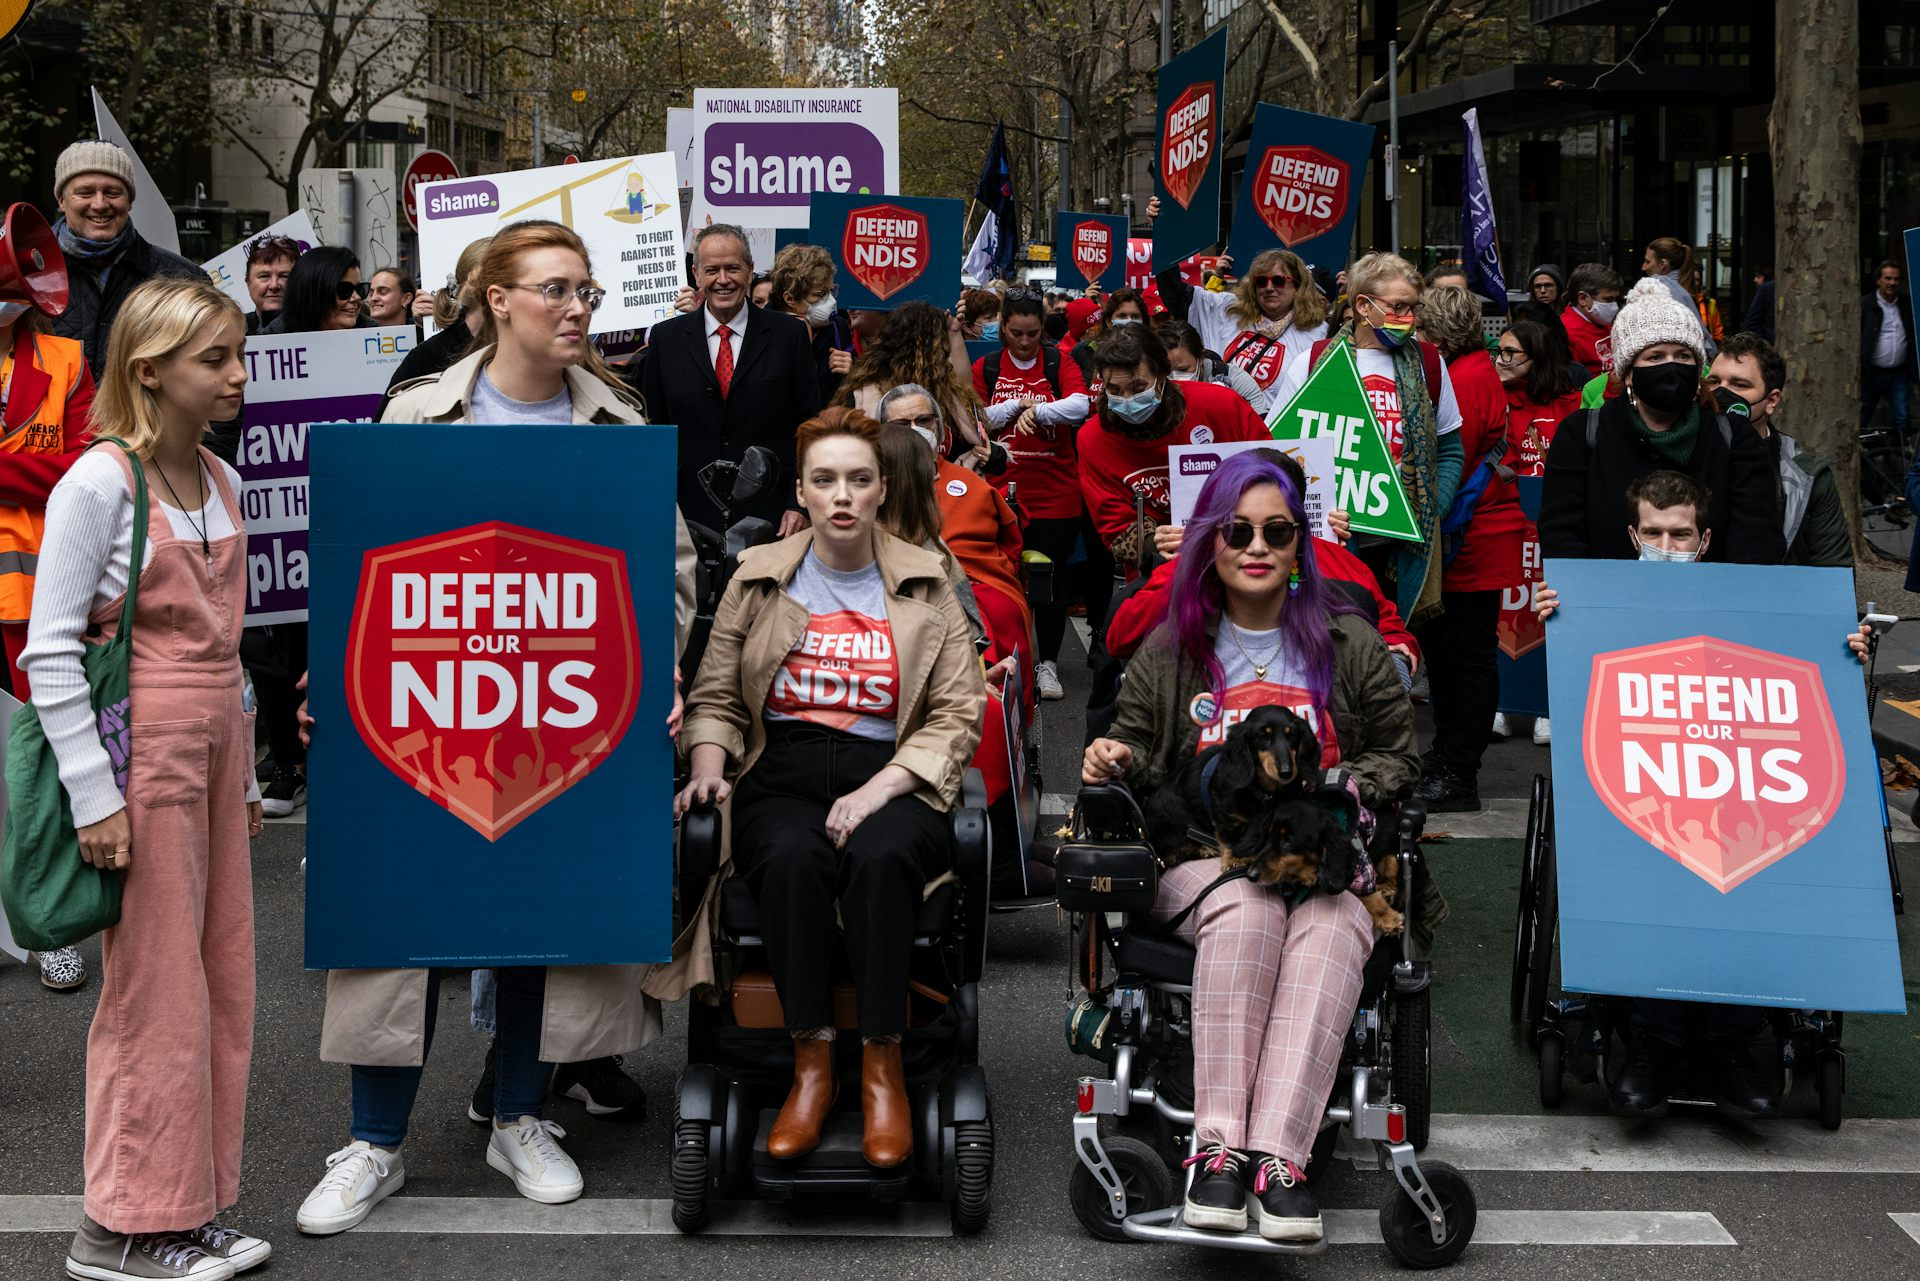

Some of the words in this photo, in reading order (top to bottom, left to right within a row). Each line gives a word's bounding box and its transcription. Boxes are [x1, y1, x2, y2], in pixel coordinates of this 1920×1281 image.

[706, 99, 751, 114] NATIONAL
[754, 99, 805, 114] DISABILITY
[808, 99, 862, 114] INSURANCE
[1170, 93, 1210, 138] DEFEND
[1183, 126, 1195, 139] OUR
[1168, 129, 1208, 176] NDIS
[1270, 154, 1340, 188] DEFEND
[1292, 179, 1311, 191] OUR
[1264, 183, 1334, 219] NDIS
[636, 233, 648, 245] TO
[648, 230, 674, 244] FIGHT
[856, 217, 919, 239] DEFEND
[1078, 228, 1108, 244] DEFEND
[877, 237, 895, 245] OUR
[621, 247, 658, 263] AGAINST
[658, 245, 676, 258] THE
[854, 243, 918, 269] NDIS
[1077, 246, 1107, 264] NDIS
[637, 261, 665, 276] NEEDS
[666, 260, 677, 272] OF
[622, 279, 654, 293] PEOPLE
[653, 275, 678, 289] WITH
[624, 290, 679, 308] DISABILITIES
[364, 332, 410, 355] riac
[265, 347, 309, 381] THE
[995, 381, 1025, 391] Every
[1366, 390, 1401, 411] FEN
[1297, 408, 1365, 462] THE
[1182, 459, 1217, 472] shame
[279, 484, 308, 518] TH
[1306, 493, 1321, 501] FIGHT
[248, 538, 309, 607] pla
[391, 572, 597, 630] DEFEND
[466, 634, 522, 654] OUR
[820, 658, 850, 671] OUR
[391, 660, 598, 730] NDIS
[774, 666, 893, 710] NDIS
[1617, 672, 1799, 724] DEFEND
[1686, 723, 1734, 740] OUR
[1621, 740, 1809, 804] NDIS
